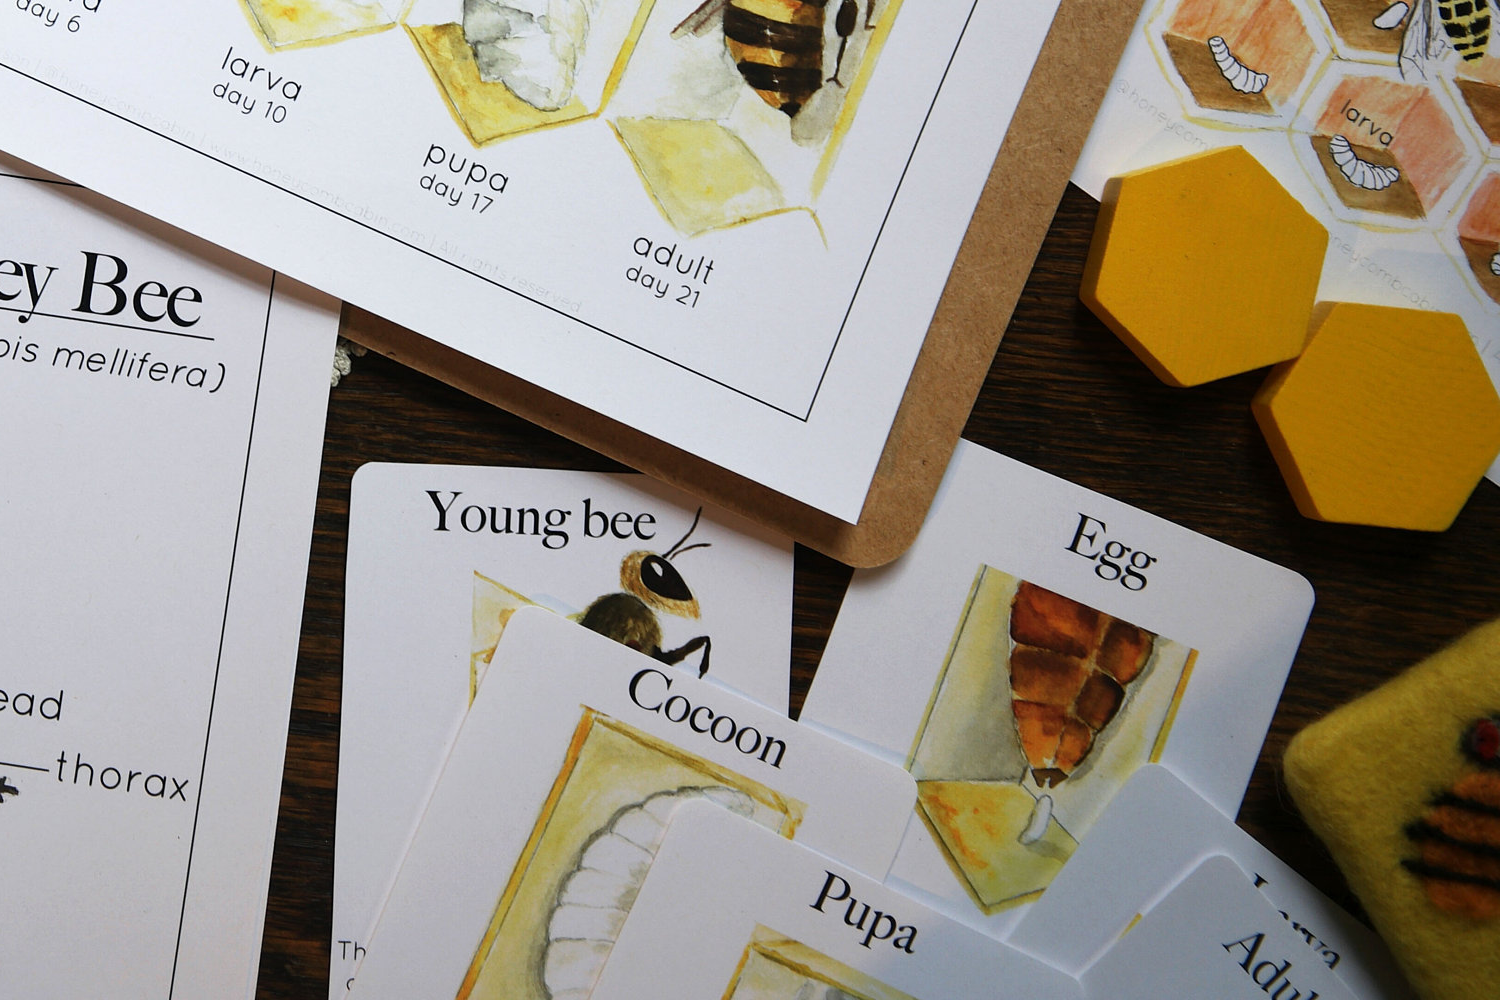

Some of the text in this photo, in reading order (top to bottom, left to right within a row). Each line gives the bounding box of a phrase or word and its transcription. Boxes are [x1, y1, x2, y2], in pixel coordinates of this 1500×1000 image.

[67, 15, 80, 32] 6
[222, 46, 302, 101] larva
[213, 82, 286, 123] day 10
[1341, 99, 1394, 148] larva
[420, 174, 493, 213] day 17
[423, 144, 508, 193] pupa
[634, 237, 713, 284] adult
[71, 250, 203, 327] Bee
[626, 266, 700, 308] day 21
[52, 347, 225, 393] mellifera)
[425, 490, 656, 549] Young bee
[1065, 512, 1157, 591] Egg
[629, 669, 786, 769] Cocoon
[57, 751, 189, 802] thorax
[809, 870, 917, 954] Pupa
[1222, 932, 1319, 1000] Adu
